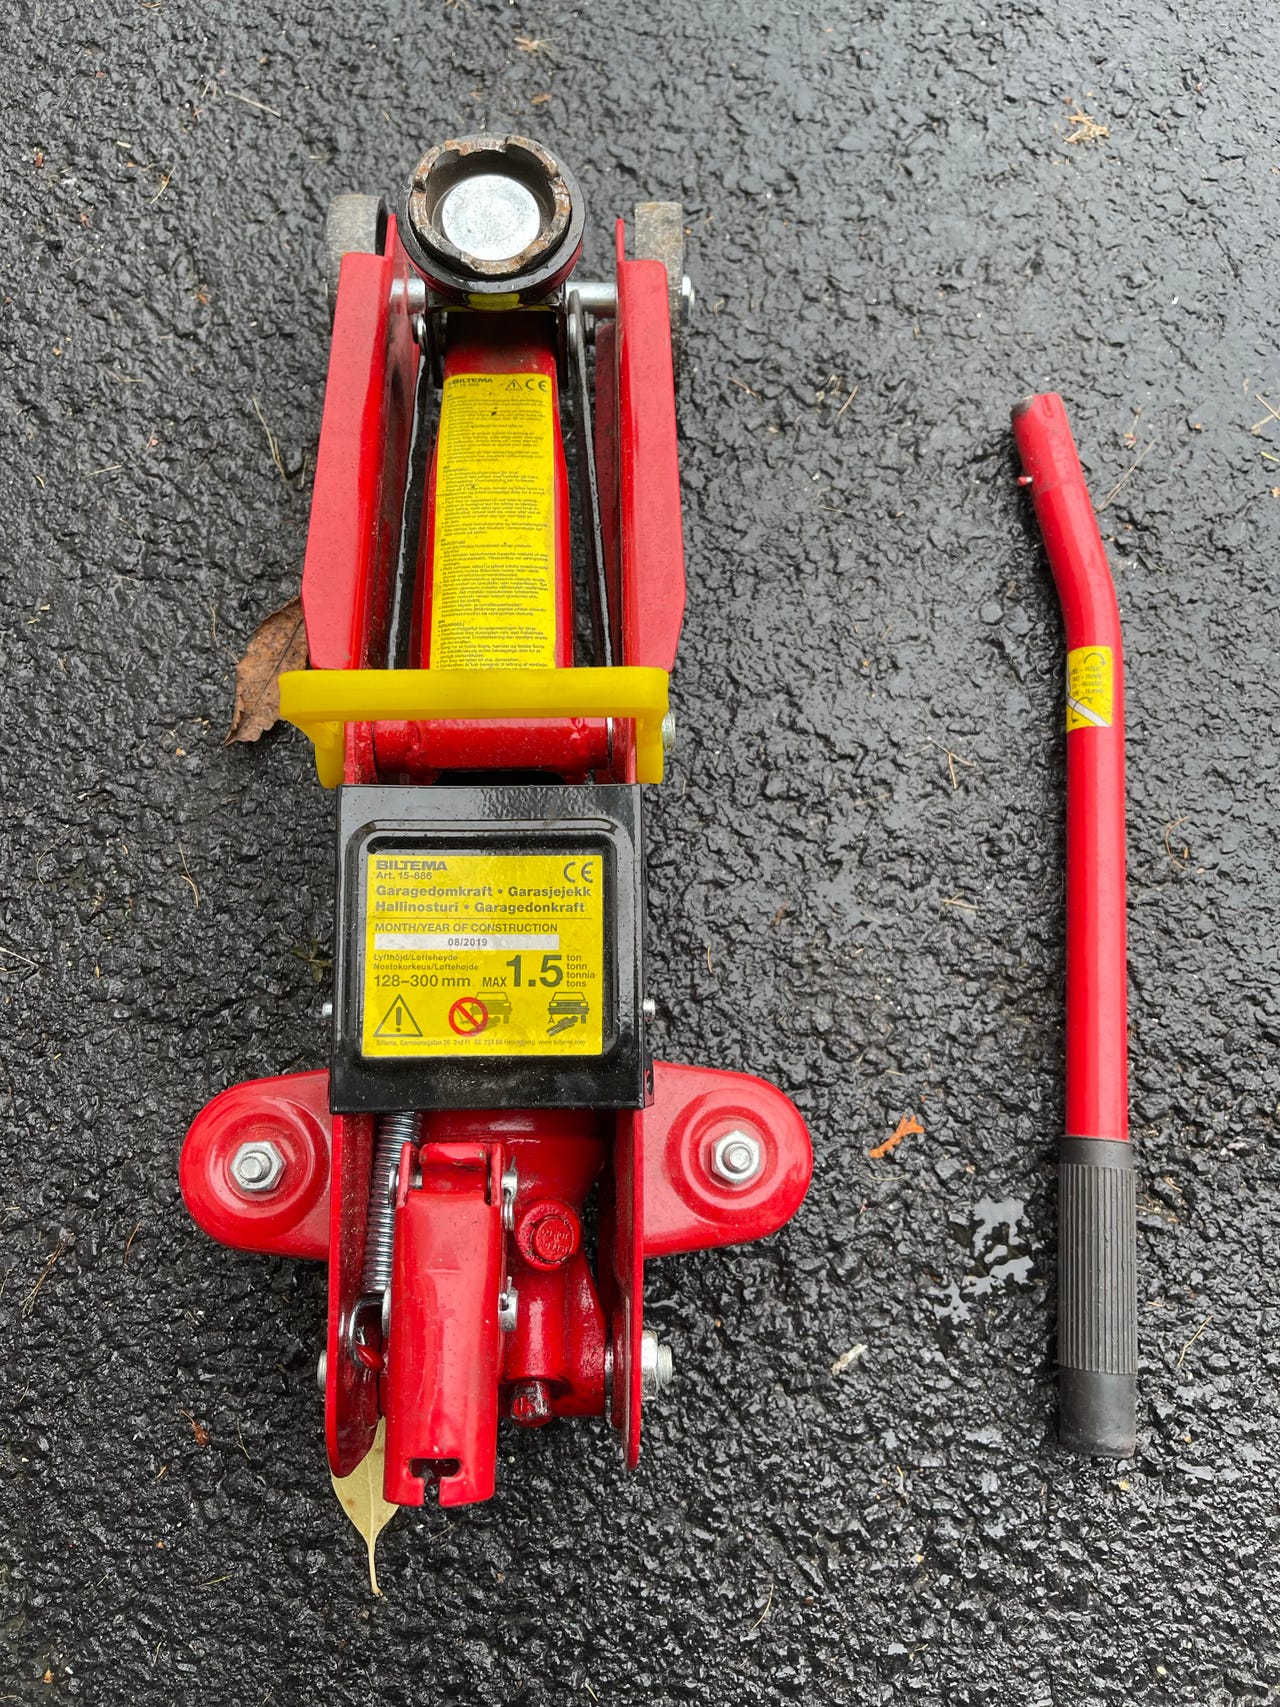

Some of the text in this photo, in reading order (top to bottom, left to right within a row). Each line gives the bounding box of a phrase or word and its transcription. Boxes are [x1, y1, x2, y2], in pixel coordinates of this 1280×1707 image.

[376, 860, 448, 871] BILTEMA
[376, 871, 432, 880] Art. 15-886
[376, 885, 591, 899] Garagedomkraft Garasjejekk
[375, 901, 585, 915] Hallinosturi Garagedonkraft
[374, 923, 558, 933] MONTH/YEAR OF CONSTRUCTION
[447, 937, 488, 947] 08/2019
[566, 953, 582, 962] ton
[441, 976, 471, 987] mm
[482, 976, 507, 987] MAX
[506, 954, 564, 987] 1.5
[566, 962, 588, 970] tonn
[566, 971, 596, 979] tonnia
[566, 980, 588, 988] tons
